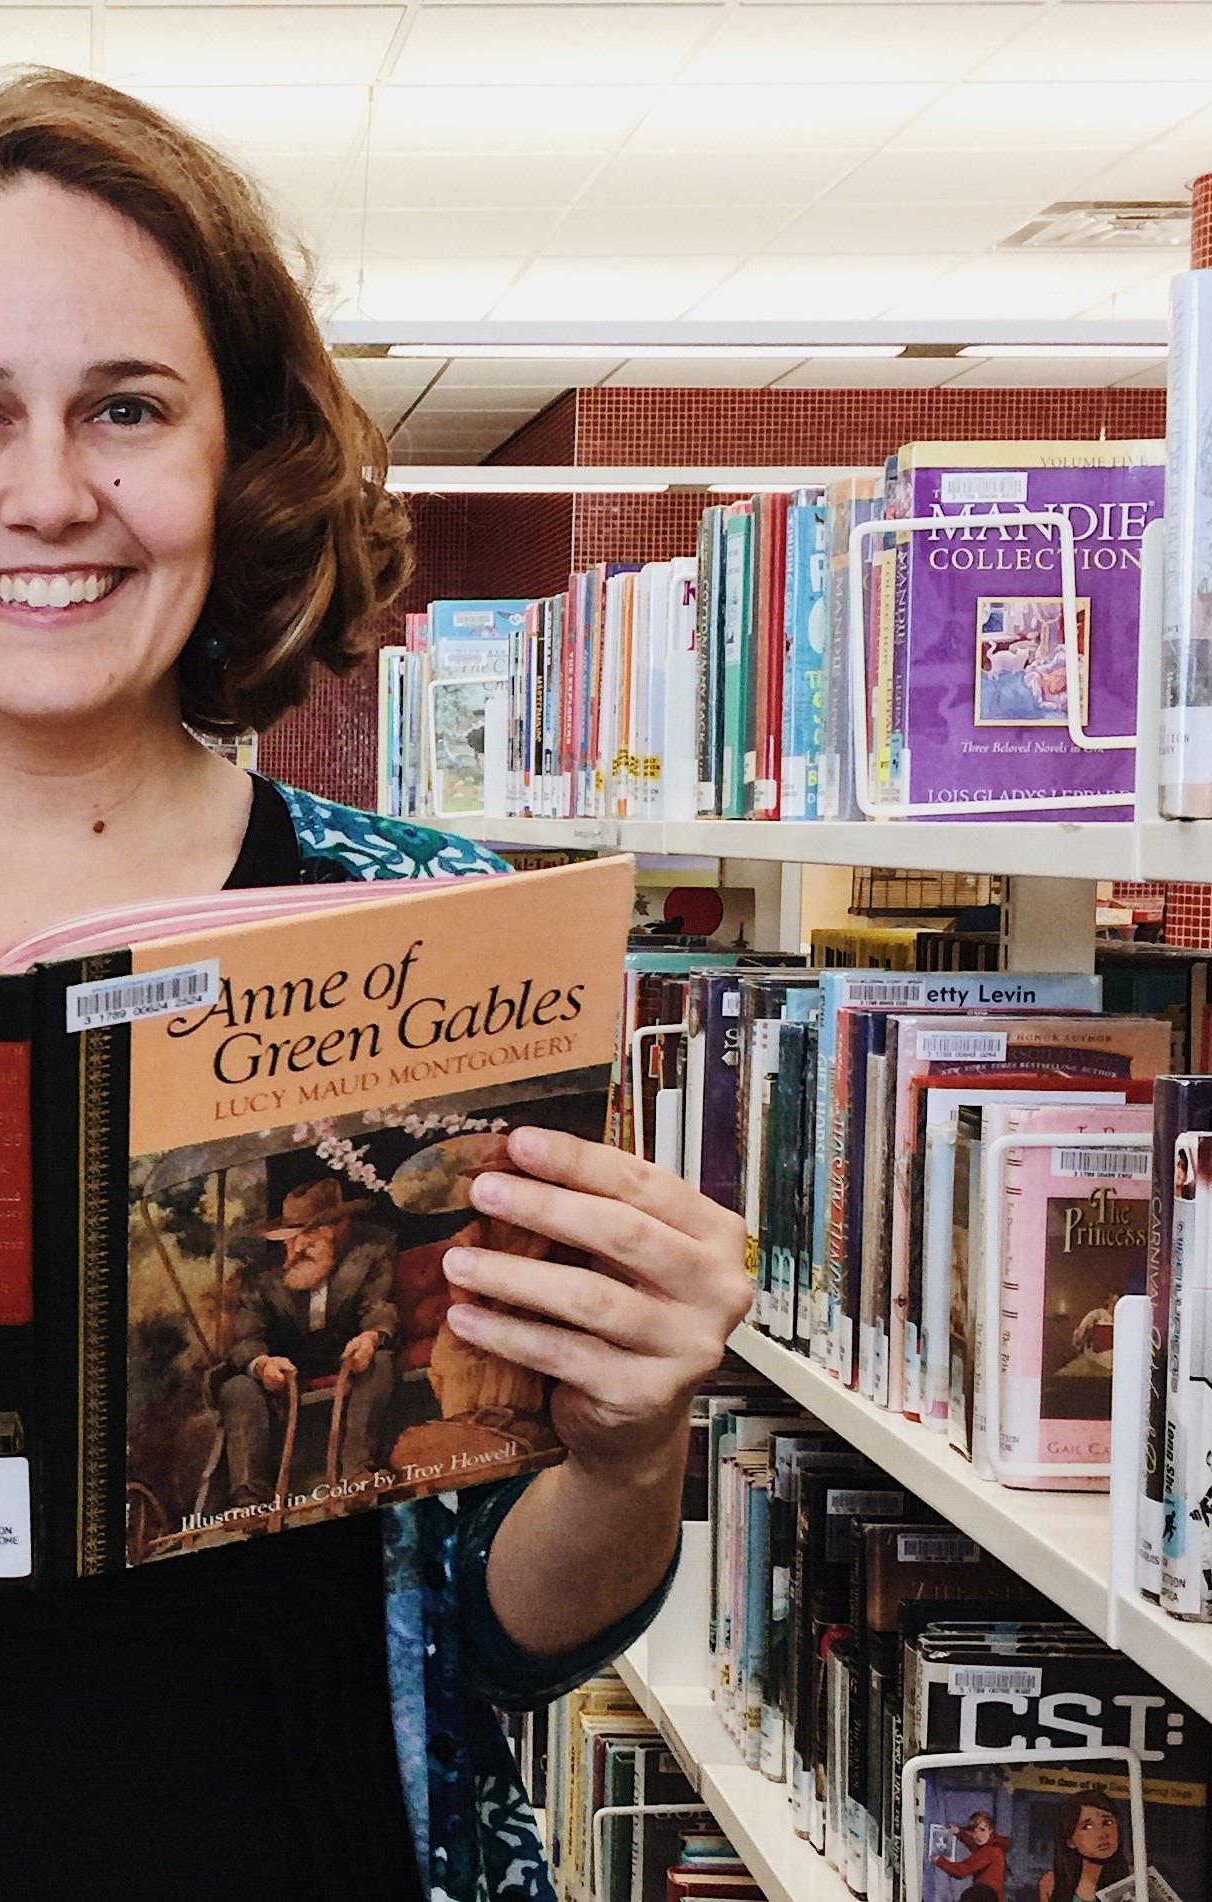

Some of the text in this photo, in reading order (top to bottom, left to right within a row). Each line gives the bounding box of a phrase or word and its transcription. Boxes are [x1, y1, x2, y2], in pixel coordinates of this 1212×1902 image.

[927, 501, 1148, 542] MANDIE
[929, 547, 1143, 571] COLLECION
[961, 741, 990, 754] Three
[992, 741, 1031, 754] Beloved
[1034, 741, 1067, 754] Novels
[167, 940, 423, 1038] Anne of
[927, 985, 1037, 1007] etty Levin
[214, 979, 585, 1085] Green Gables
[1016, 1033, 1112, 1043] HONOR AUTHOR
[214, 1032, 579, 1121] LUCY MAUD MONTGOMERY
[1020, 1061, 1077, 1072] BESTSELLING
[1089, 1187, 1132, 1225] The
[1063, 1206, 1148, 1254] Princess
[1046, 1441, 1082, 1455] GAIL
[181, 1440, 518, 1533] Illustrated in Color by Troy Howell
[959, 1692, 1184, 1761] CSI:
[1038, 1775, 1056, 1786] The
